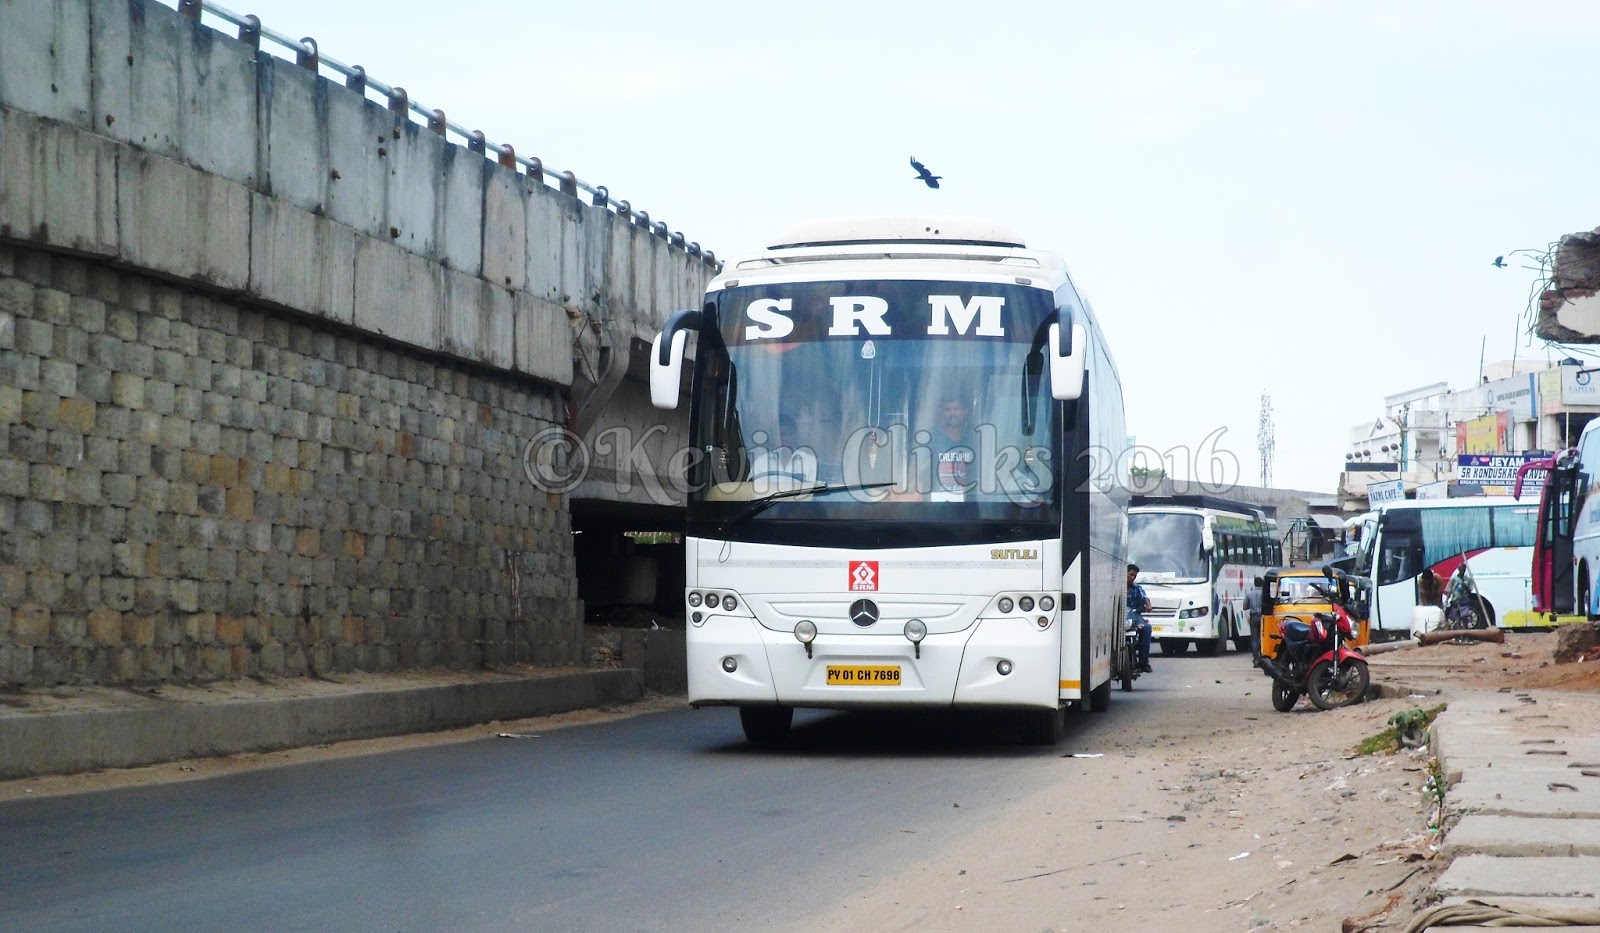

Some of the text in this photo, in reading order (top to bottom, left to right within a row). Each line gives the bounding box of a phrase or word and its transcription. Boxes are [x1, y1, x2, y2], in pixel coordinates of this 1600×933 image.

[1489, 457, 1525, 467] JEYAM
[1461, 467, 1471, 478] SR
[1473, 467, 1517, 479] KONDUSKAR
[990, 549, 1038, 560] SUTLEJ
[828, 670, 900, 681] PY 01 CH 7698
